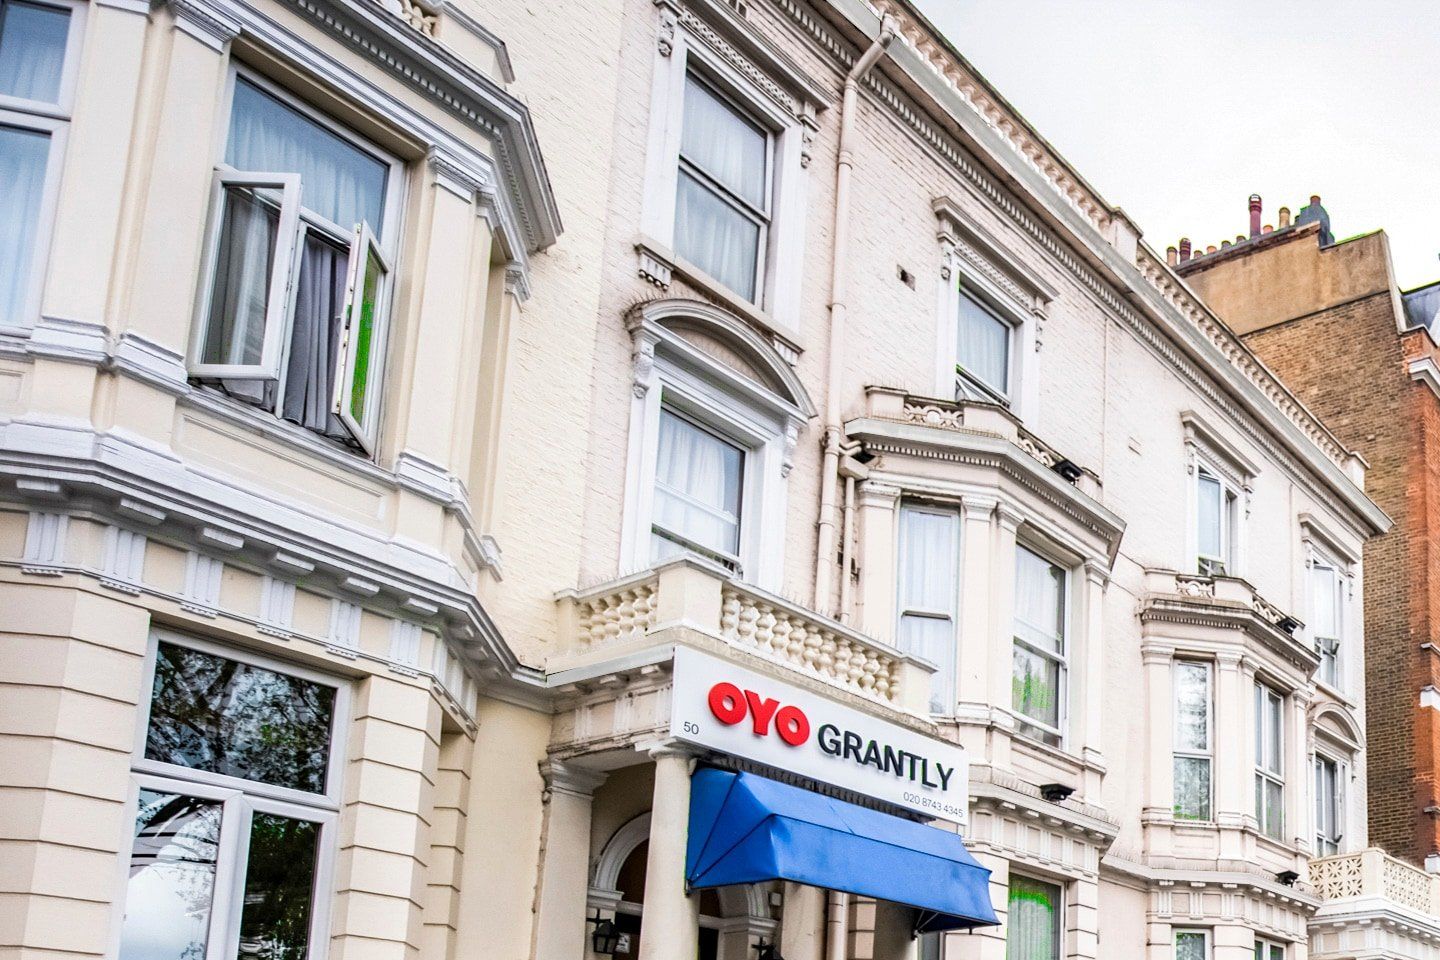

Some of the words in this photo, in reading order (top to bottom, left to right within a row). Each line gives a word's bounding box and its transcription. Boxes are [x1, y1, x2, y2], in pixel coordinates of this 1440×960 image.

[683, 720, 700, 735] 50
[707, 681, 811, 747] OYO
[817, 723, 954, 792] GRANTLY
[903, 791, 921, 805] 020
[922, 797, 942, 812] 8743
